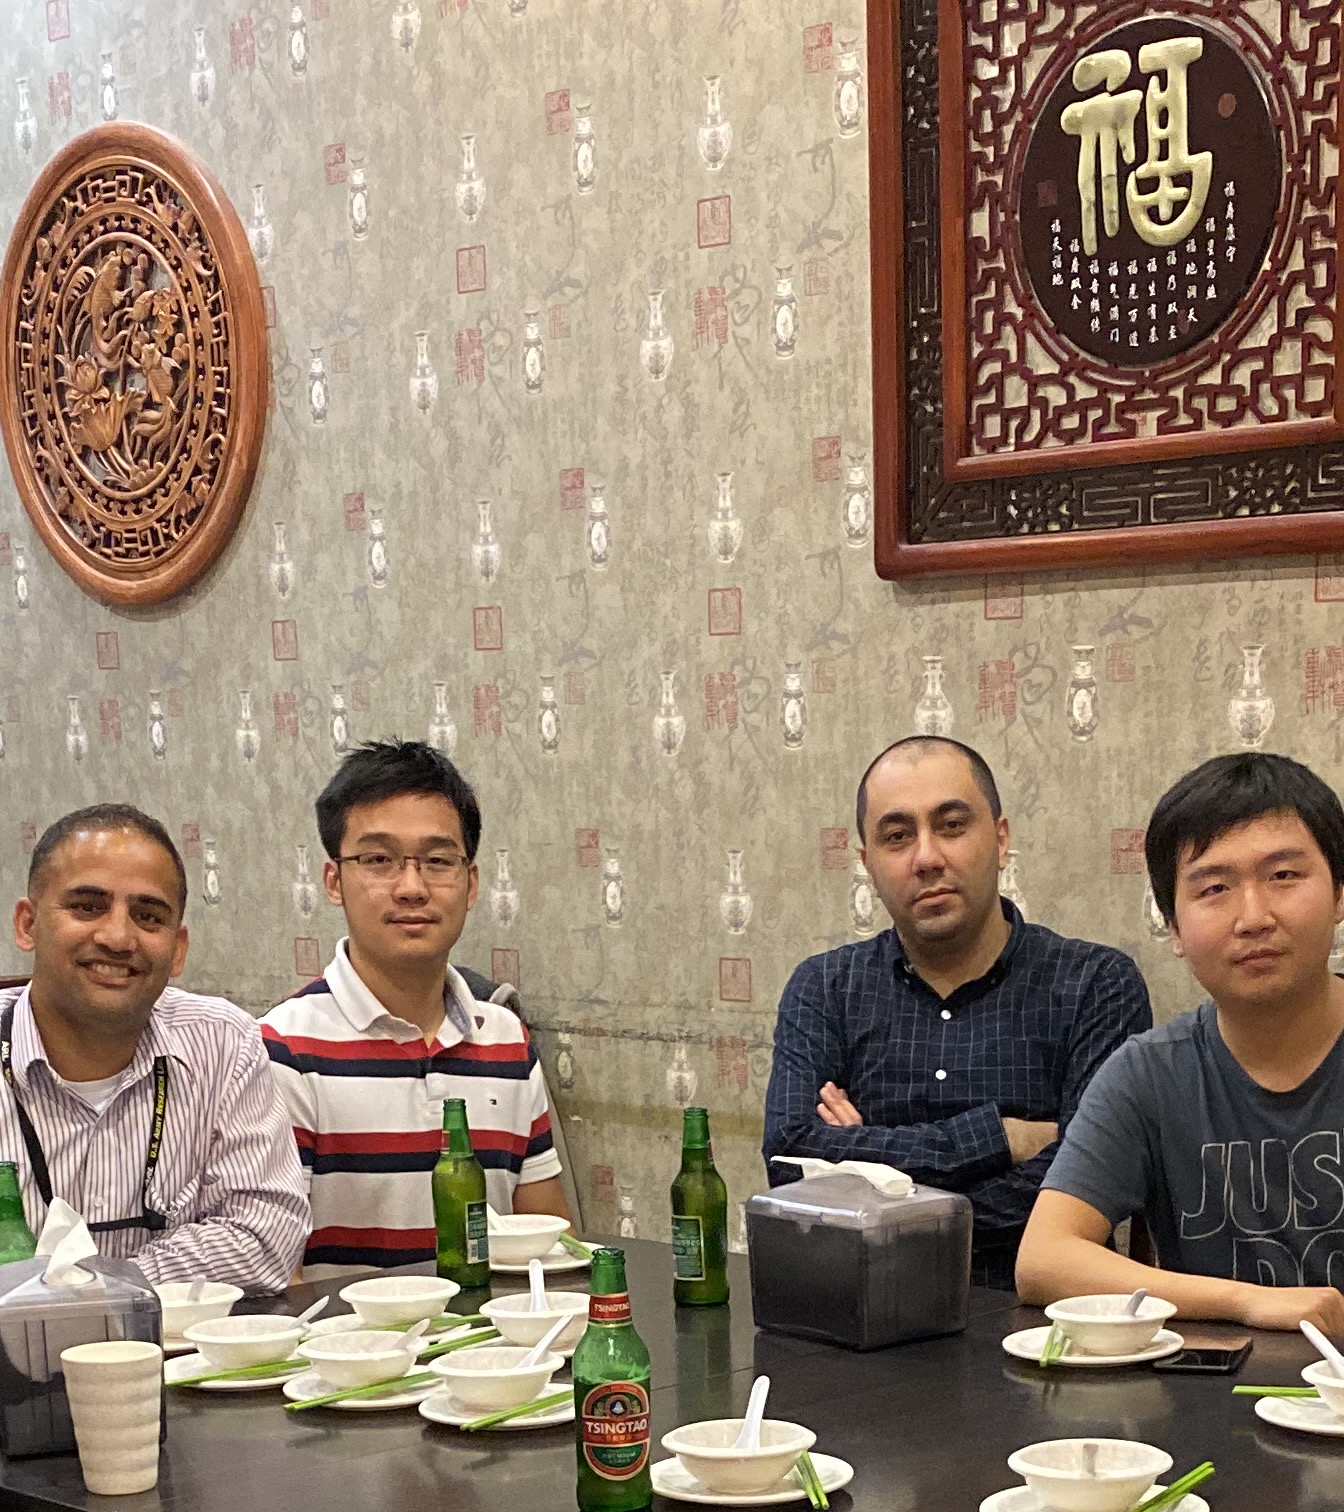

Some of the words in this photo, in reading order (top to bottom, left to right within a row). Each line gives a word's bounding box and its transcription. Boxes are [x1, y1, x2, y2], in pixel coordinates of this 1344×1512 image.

[1060, 37, 1213, 257] 福
[594, 1302, 630, 1312] TSINGTAO
[586, 1418, 647, 1435] TSINGTAO
